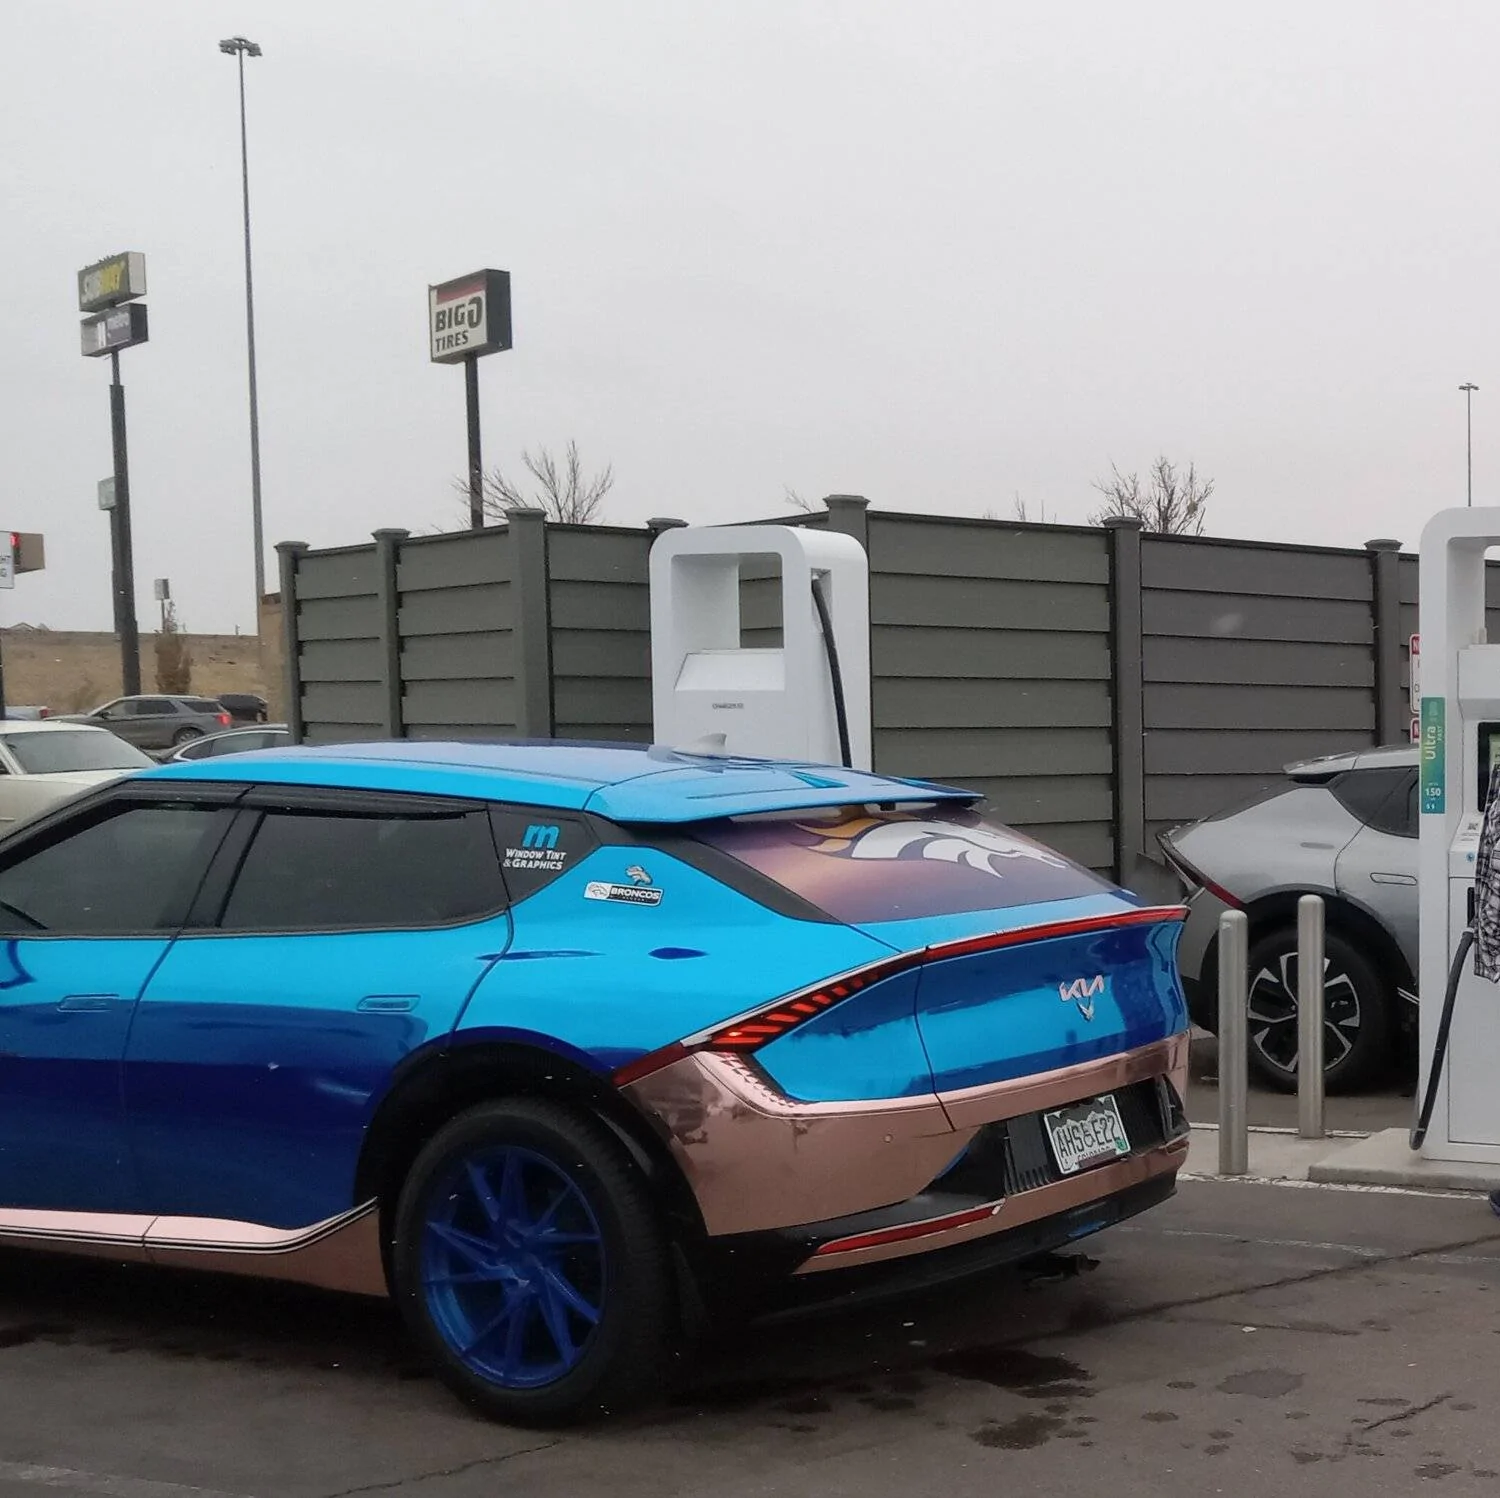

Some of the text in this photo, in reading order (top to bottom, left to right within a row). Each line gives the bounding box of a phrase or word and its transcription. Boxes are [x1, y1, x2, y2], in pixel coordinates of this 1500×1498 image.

[435, 303, 466, 333] BIG
[435, 329, 469, 353] TIRES
[1424, 725, 1437, 760] Ultra
[1425, 787, 1441, 797] 150
[610, 887, 660, 900] BRONCOS
